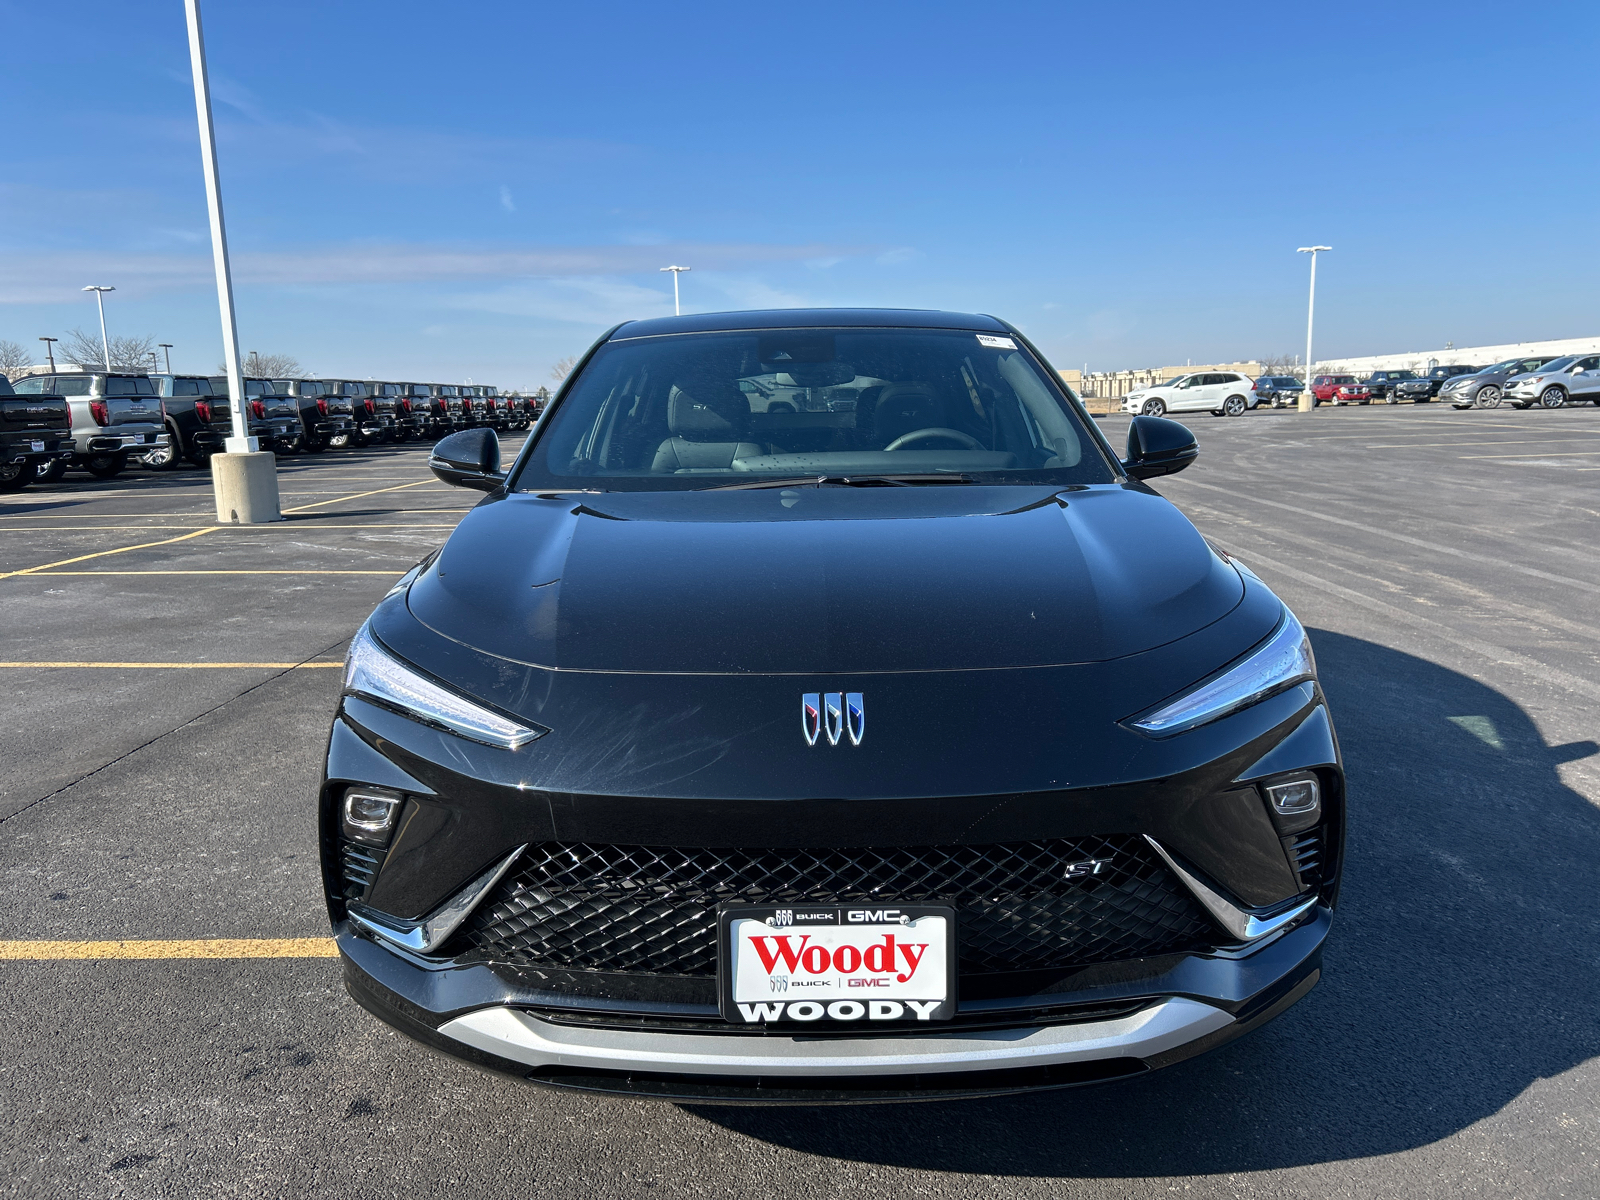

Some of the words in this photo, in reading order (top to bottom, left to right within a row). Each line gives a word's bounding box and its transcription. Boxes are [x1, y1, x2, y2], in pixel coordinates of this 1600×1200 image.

[847, 910, 901, 922] GMC
[747, 934, 929, 983] Woody
[847, 978, 890, 988] GMC
[736, 1001, 942, 1023] WOODY
